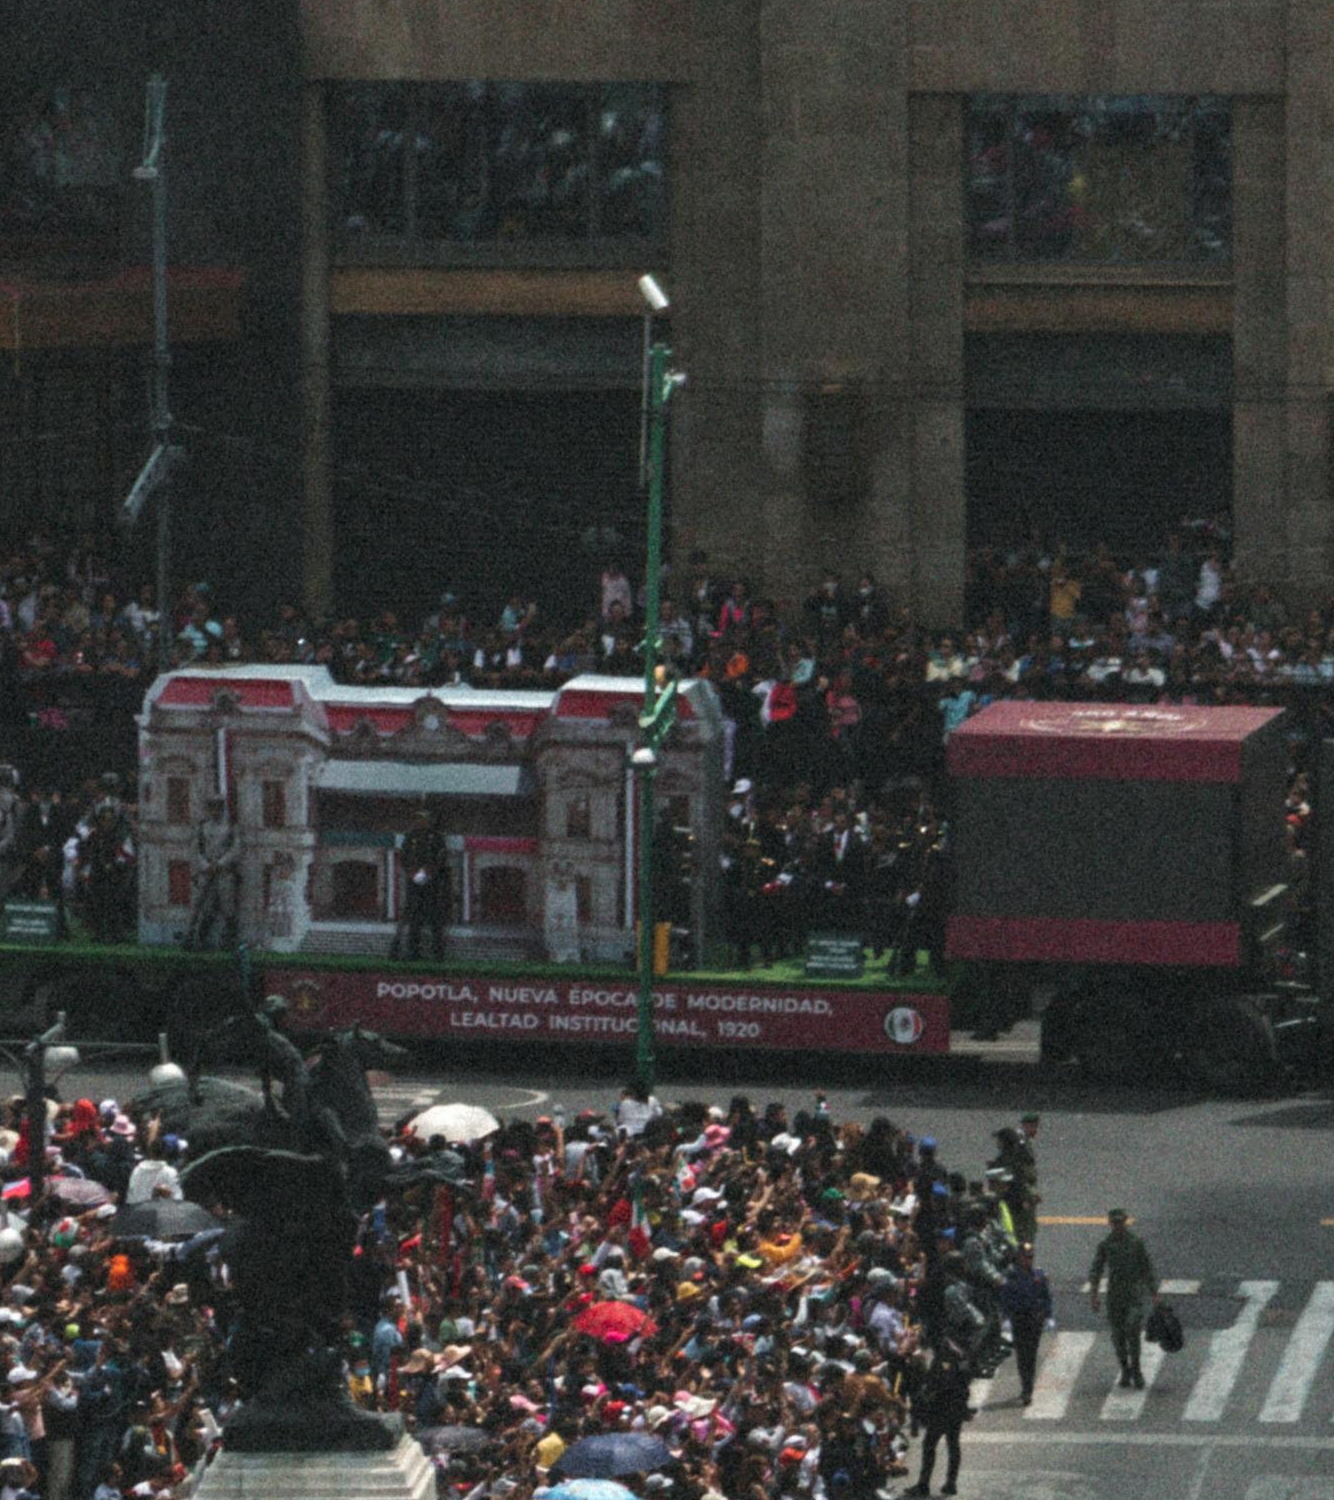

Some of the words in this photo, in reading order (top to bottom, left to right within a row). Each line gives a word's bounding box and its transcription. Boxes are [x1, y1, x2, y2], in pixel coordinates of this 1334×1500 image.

[376, 983, 479, 1004] POPOTLA,
[489, 986, 559, 1004] NUEVA
[687, 994, 833, 1017] MODERNIDAD,
[450, 1009, 539, 1030] LEALTAD
[717, 1021, 761, 1038] 1920
